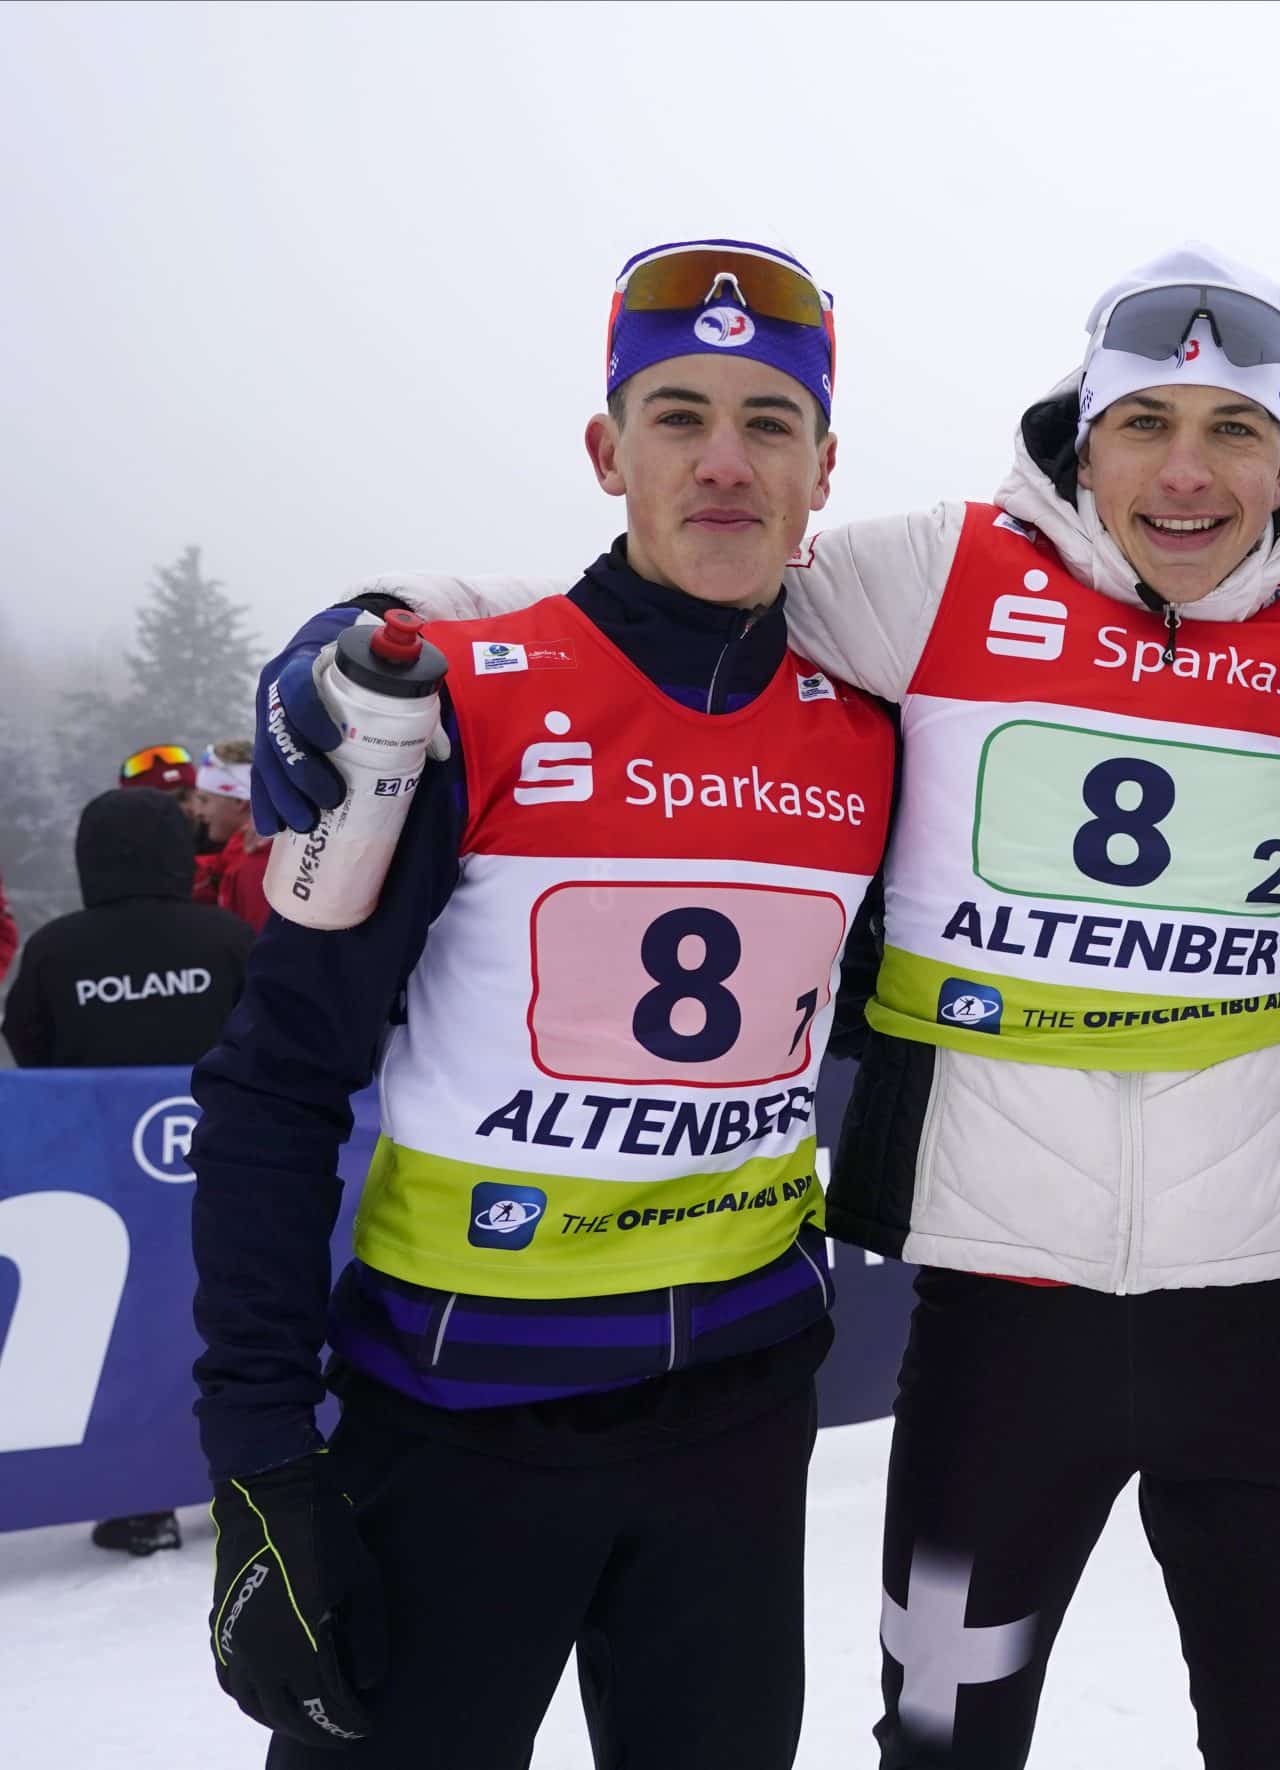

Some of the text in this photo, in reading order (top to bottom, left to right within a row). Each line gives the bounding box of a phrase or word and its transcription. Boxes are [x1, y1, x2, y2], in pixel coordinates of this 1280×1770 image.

[625, 758, 866, 826] Sparkasse
[1072, 757, 1177, 888] 8
[75, 966, 212, 1006] POLAND
[632, 906, 742, 1063] 8
[1022, 1008, 1075, 1030] THE
[1083, 1002, 1215, 1029] OFFICIAL
[1220, 996, 1260, 1017] IBU
[475, 1086, 815, 1157] ALTENBER
[560, 1213, 614, 1235] THE
